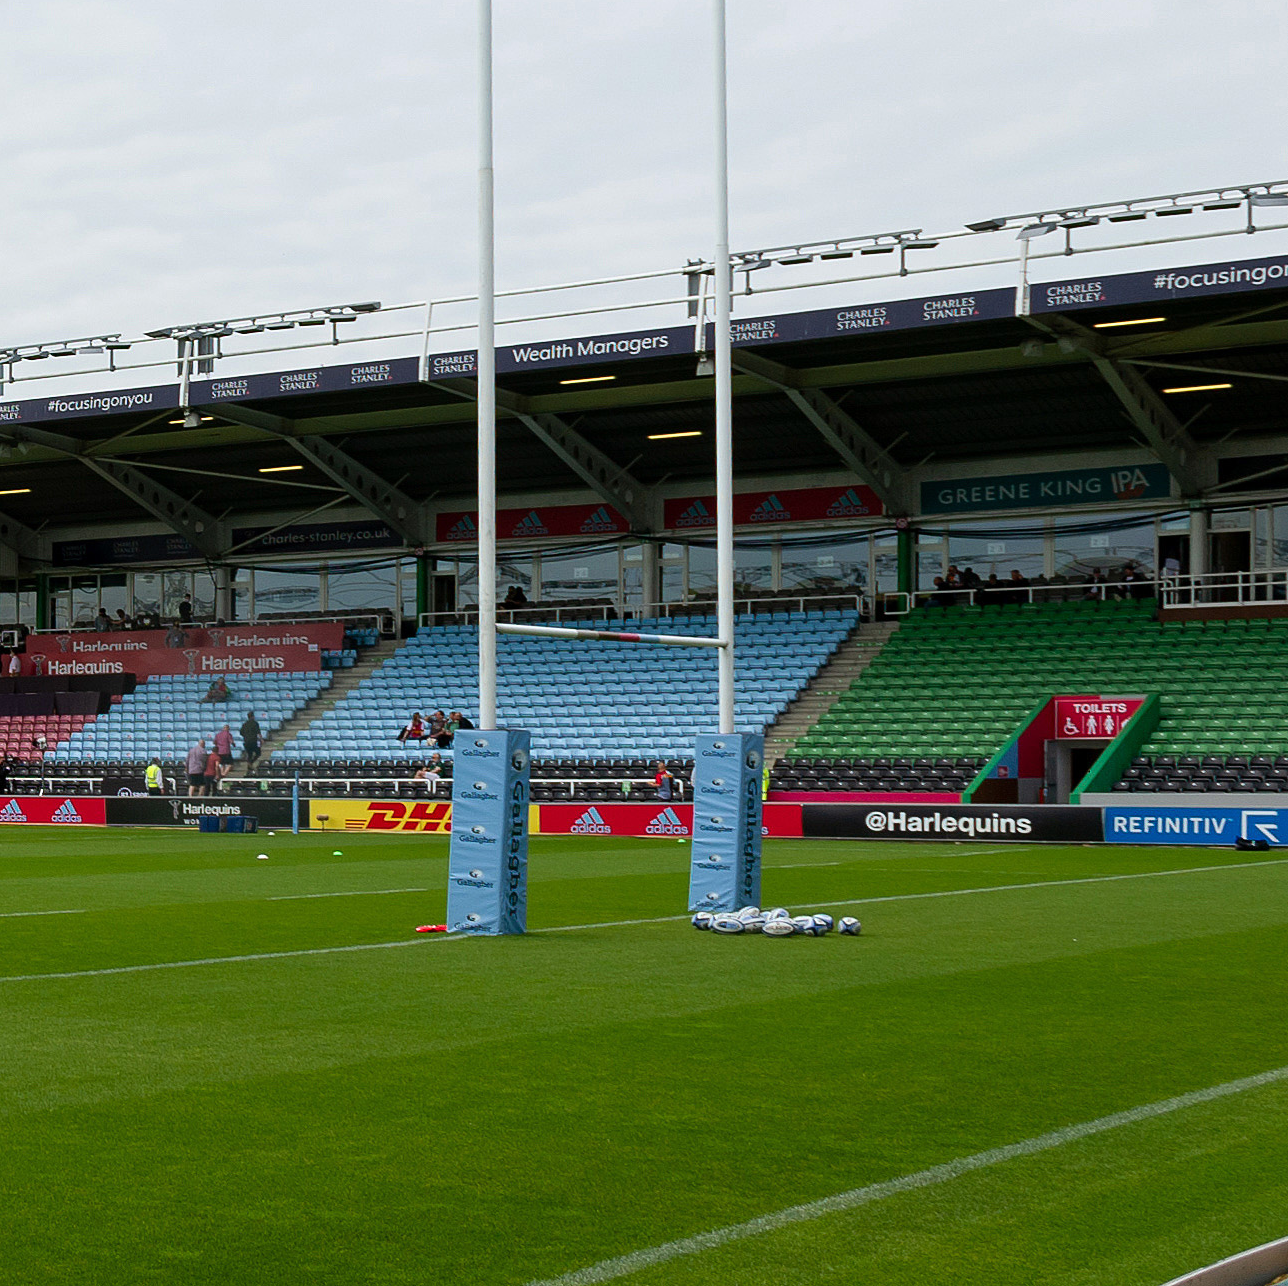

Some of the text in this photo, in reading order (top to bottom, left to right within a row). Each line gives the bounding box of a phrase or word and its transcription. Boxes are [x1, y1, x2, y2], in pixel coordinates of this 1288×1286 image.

[1047, 282, 1102, 297] CHARLES
[923, 296, 975, 312] CHARLES
[1047, 292, 1101, 307] STANLEY
[836, 307, 886, 321] CHARLES
[923, 307, 974, 321] STANLEY
[729, 320, 776, 333] CHARLES
[836, 316, 885, 331] STANLEY
[729, 329, 775, 343] STANLEY
[512, 334, 669, 364] Wealth Managers
[433, 354, 475, 367] CHARLES
[351, 364, 390, 377] CHARLES
[433, 363, 473, 375] STANLEY
[280, 372, 318, 384] CHARLES
[351, 373, 389, 384] STANLEY
[211, 380, 248, 391] CHARLES
[279, 381, 316, 392] STANLEY
[211, 388, 247, 399] STANLEY
[47, 392, 153, 413] #focusingonyou
[938, 467, 1150, 506] GREENE KING IPA
[749, 509, 791, 522] adidas
[825, 503, 869, 517] adidas
[261, 528, 391, 546] charles-stanley.co.uk
[446, 528, 479, 541] adida
[48, 659, 124, 675] Harlequins
[201, 654, 285, 672] Harlequins
[1073, 702, 1127, 715] TOILETS
[182, 803, 241, 817] Harlequins
[366, 802, 451, 831] DH
[52, 815, 82, 823] adidas
[864, 811, 1032, 837] @Harlequins
[1113, 816, 1226, 834] REFINITIV
[570, 824, 612, 834] adidas
[645, 824, 689, 835] adidas
[743, 777, 758, 899] Gallagher
[508, 779, 524, 921] Gallagher
